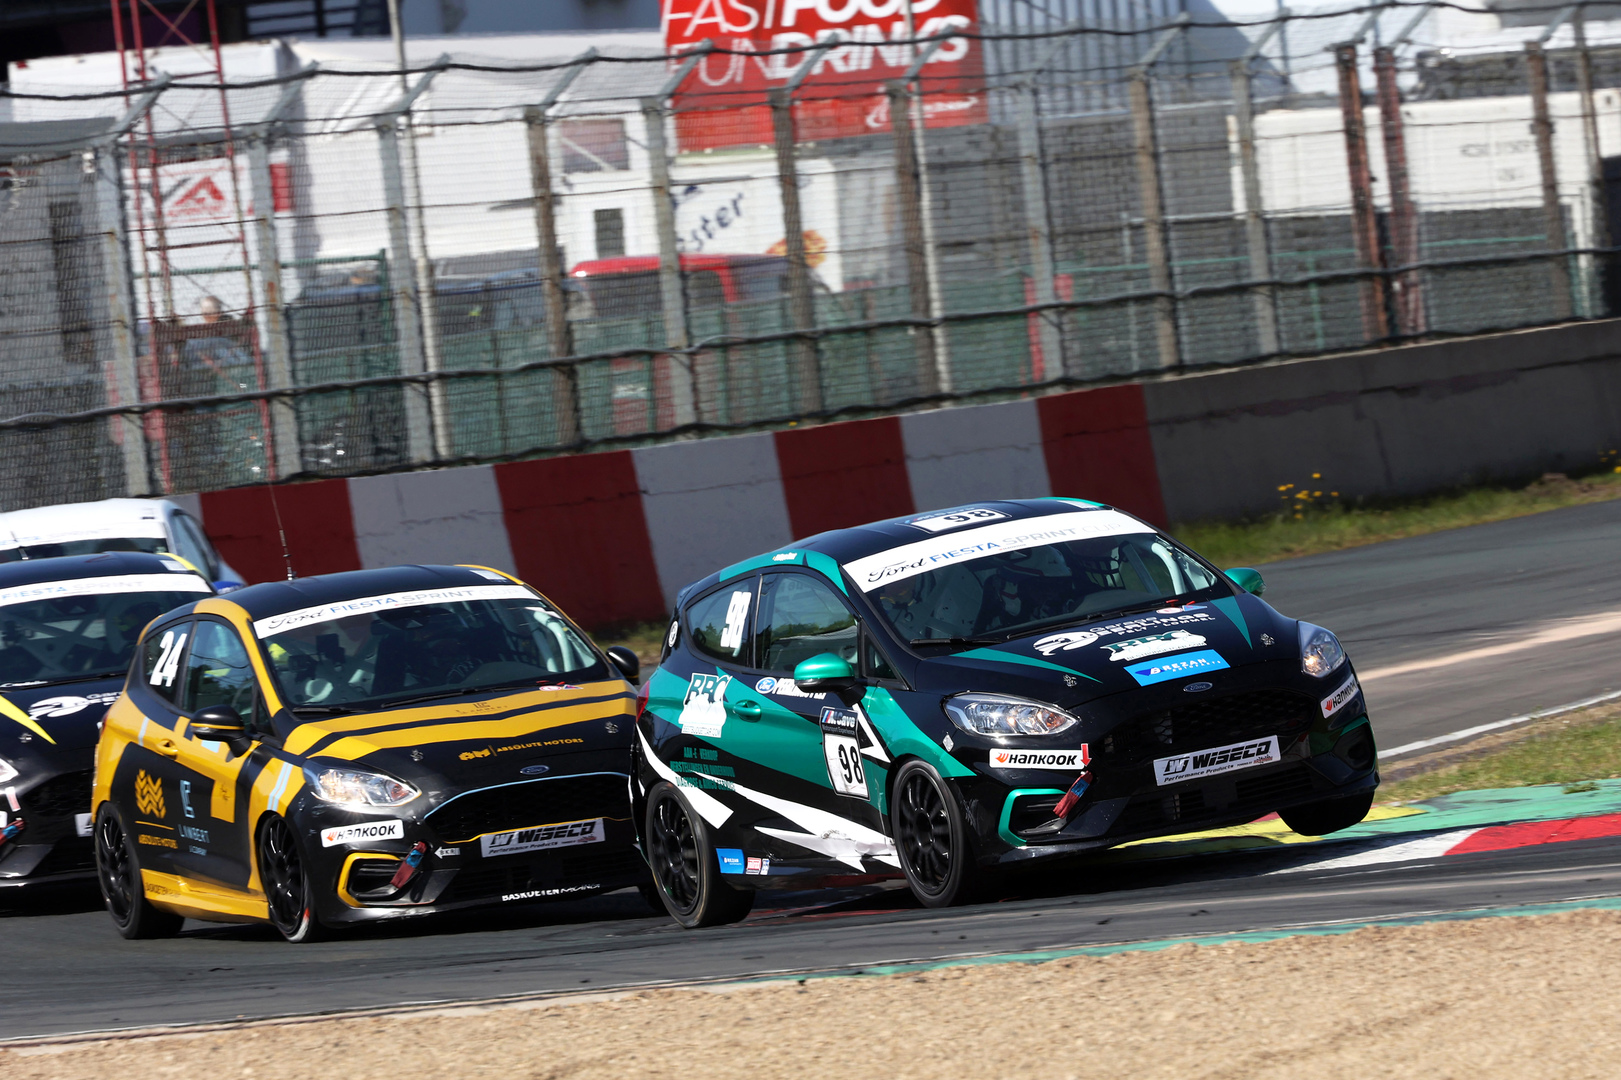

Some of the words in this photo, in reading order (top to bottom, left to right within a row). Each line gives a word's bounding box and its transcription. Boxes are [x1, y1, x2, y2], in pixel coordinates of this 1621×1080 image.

[943, 510, 996, 522] 98
[867, 557, 928, 583] Ford
[929, 541, 1001, 563] FIESTA
[1002, 528, 1080, 545] SPRINT
[1082, 523, 1121, 534] CUP
[1, 586, 67, 600] FIESTA
[268, 609, 324, 629] Ford
[330, 597, 398, 613] FIESTA
[402, 590, 476, 601] SPRINT
[720, 591, 752, 649] 98
[149, 631, 187, 687] 24
[758, 679, 774, 691] Ford
[497, 742, 542, 752] ABSOLUTE
[543, 738, 584, 747] MOTORS
[838, 744, 863, 784] 98
[1164, 771, 1205, 783] Performance
[1206, 764, 1234, 774] Products
